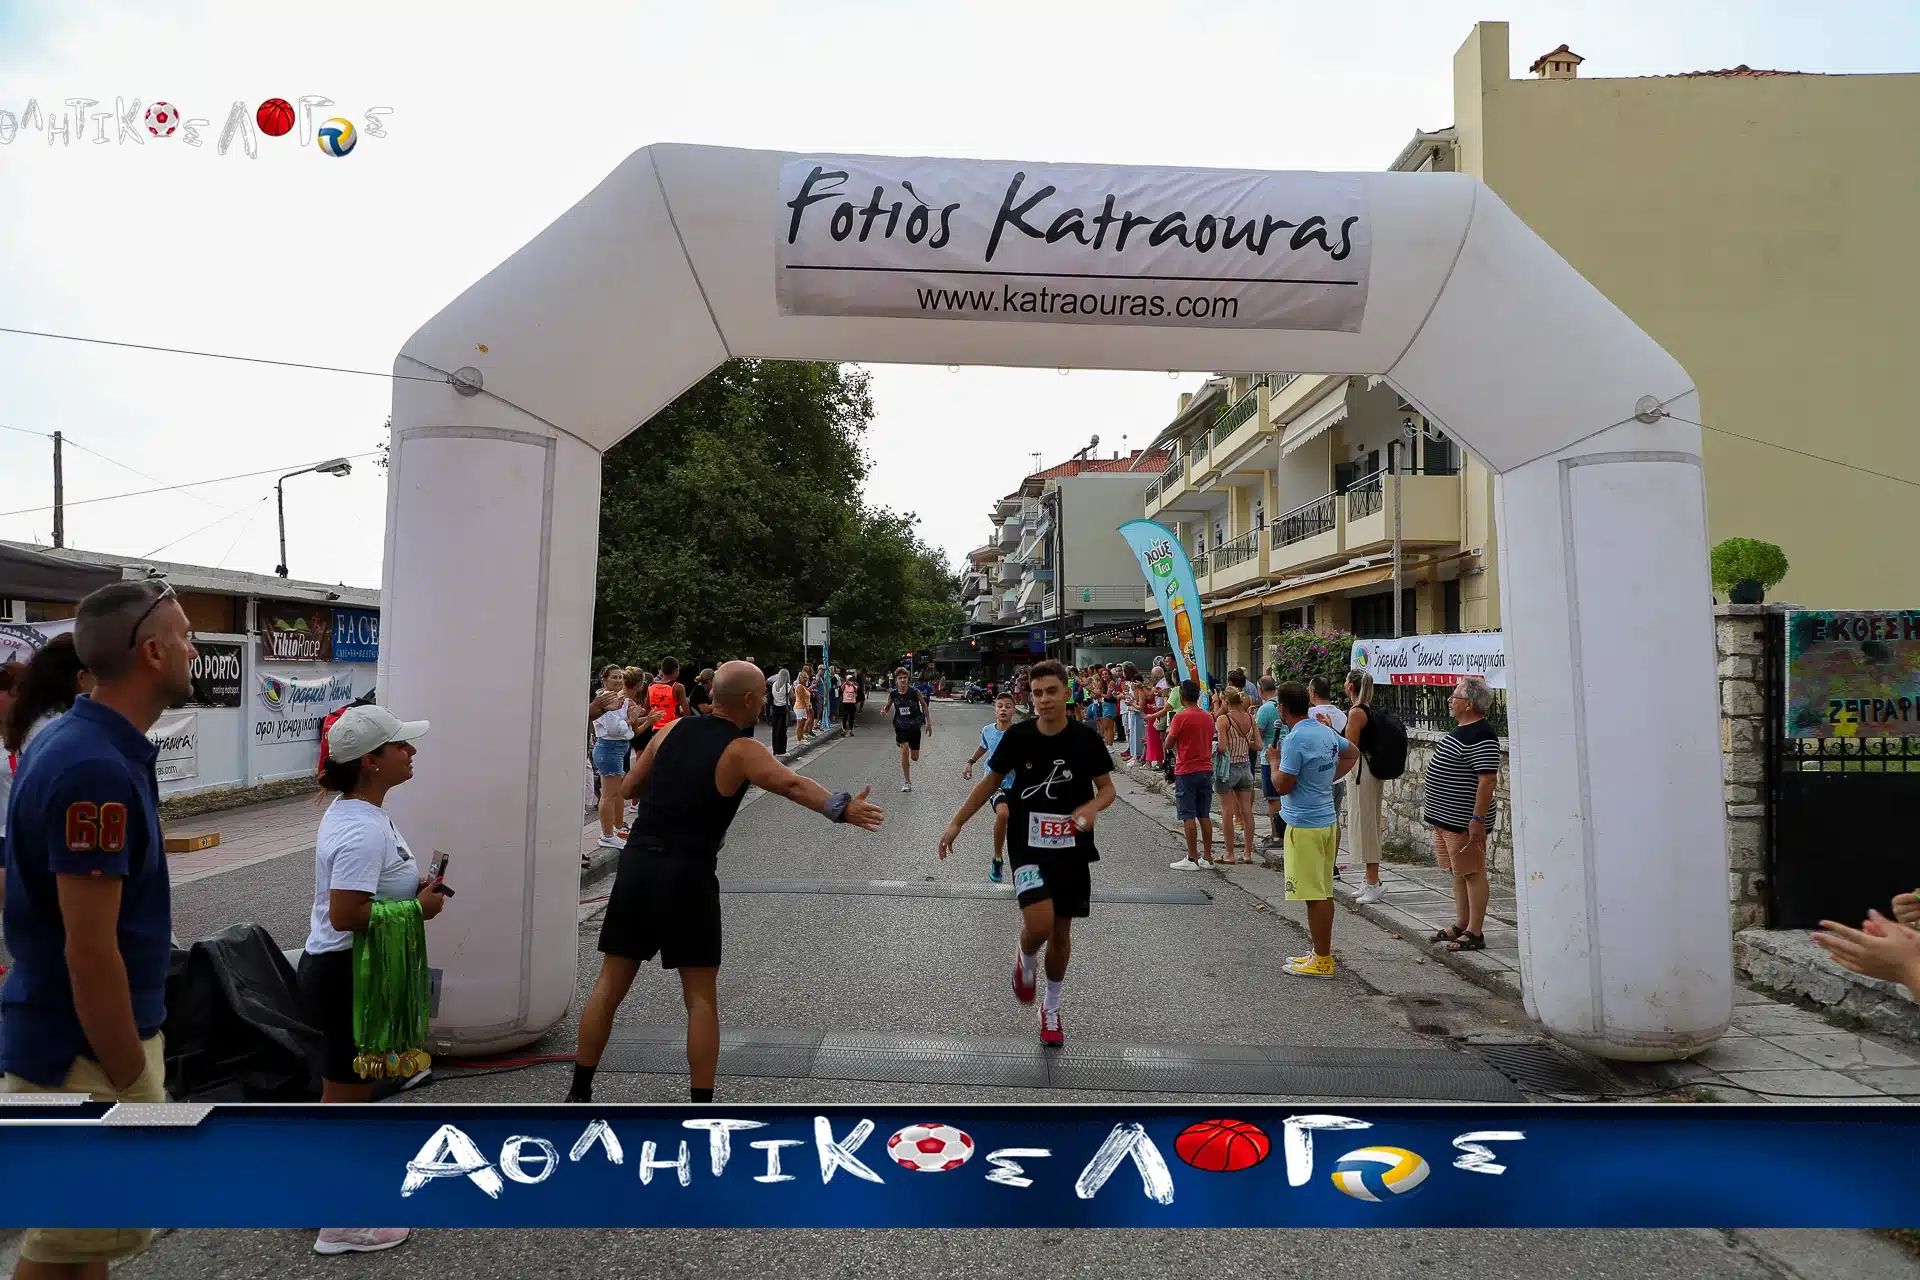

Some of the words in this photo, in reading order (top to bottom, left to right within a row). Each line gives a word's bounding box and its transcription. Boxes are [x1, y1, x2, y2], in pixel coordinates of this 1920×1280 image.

[985, 171, 1360, 262] Katraouras
[917, 284, 1239, 320] www.katraouras.com
[1155, 561, 1171, 575] Tea
[205, 655, 240, 680] PORTO
[1466, 649, 1505, 672] γεωργικόπ
[1391, 675, 1462, 684] ΤΕΡΜΑΤΙΣΜ
[66, 801, 126, 851] 68
[1044, 822, 1072, 836] 532
